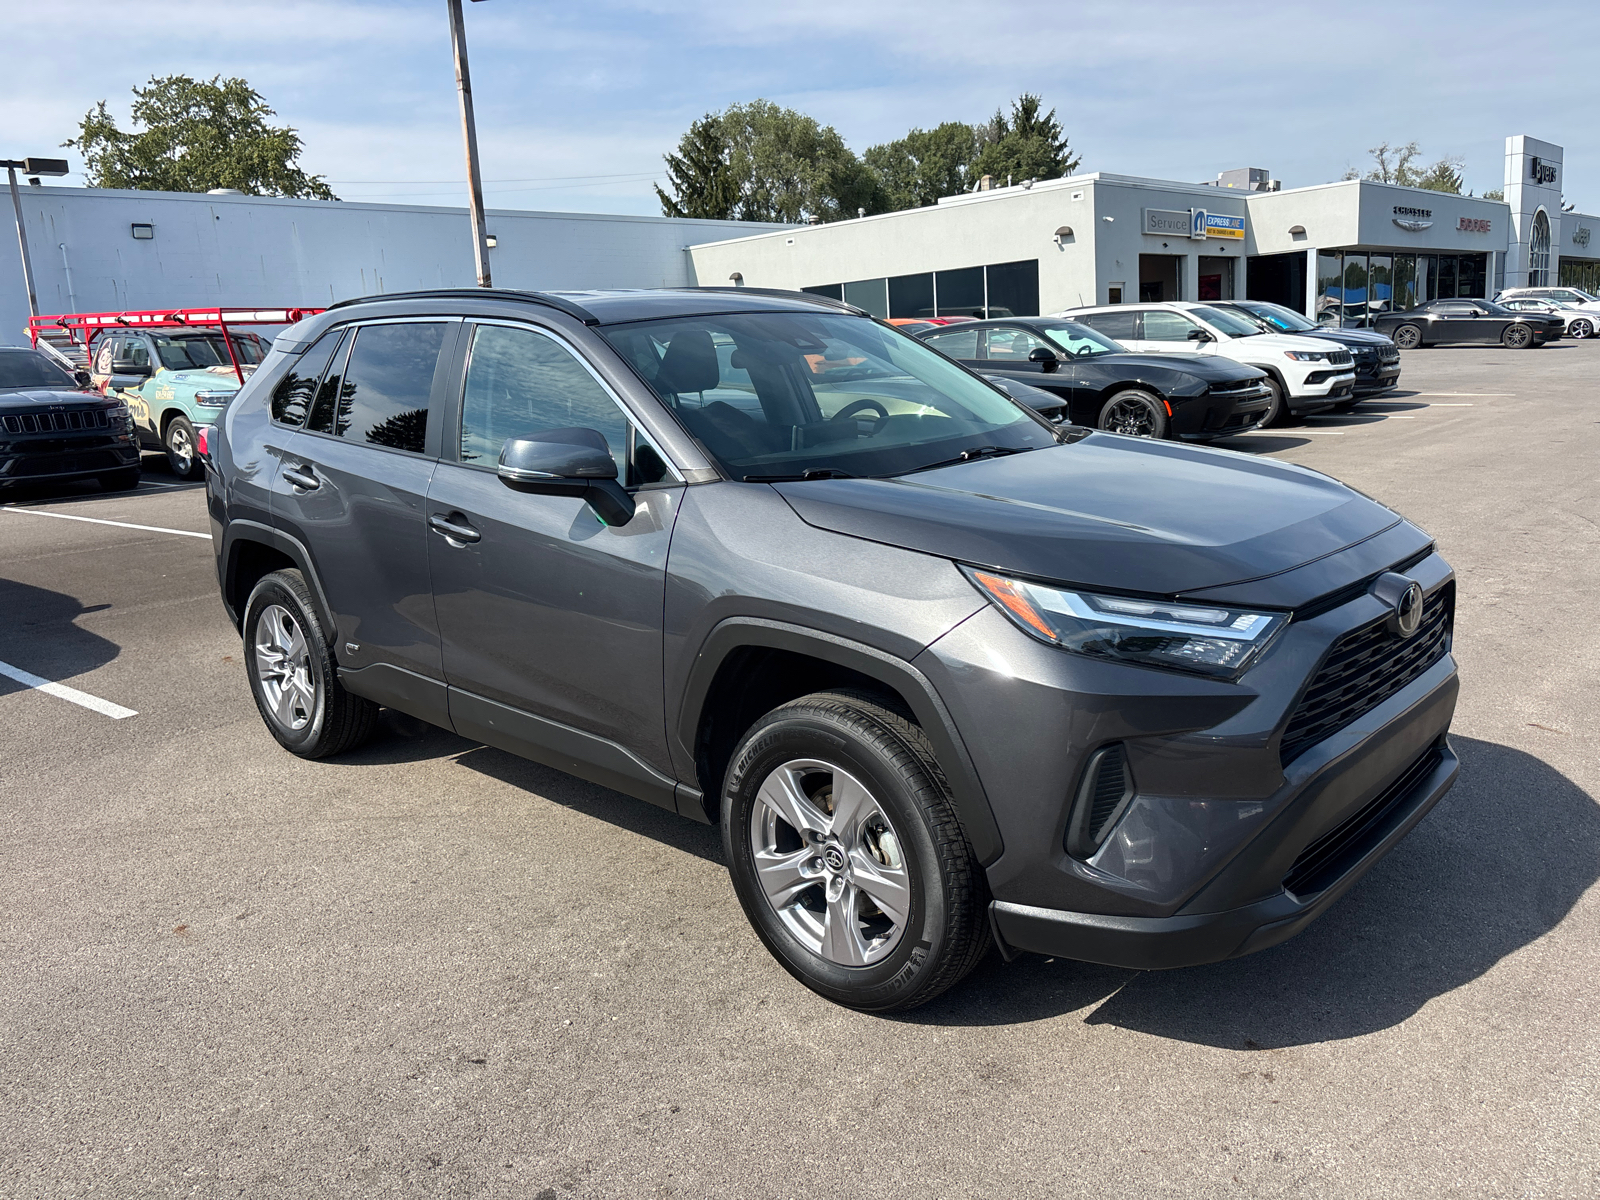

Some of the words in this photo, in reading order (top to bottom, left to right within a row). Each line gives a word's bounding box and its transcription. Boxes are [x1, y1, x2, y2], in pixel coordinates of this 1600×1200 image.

[1532, 157, 1557, 184] Byers
[1150, 215, 1187, 230] Service
[1457, 217, 1492, 232] DODGE
[1572, 222, 1591, 248] Jeep
[737, 732, 781, 775] MICHELIN
